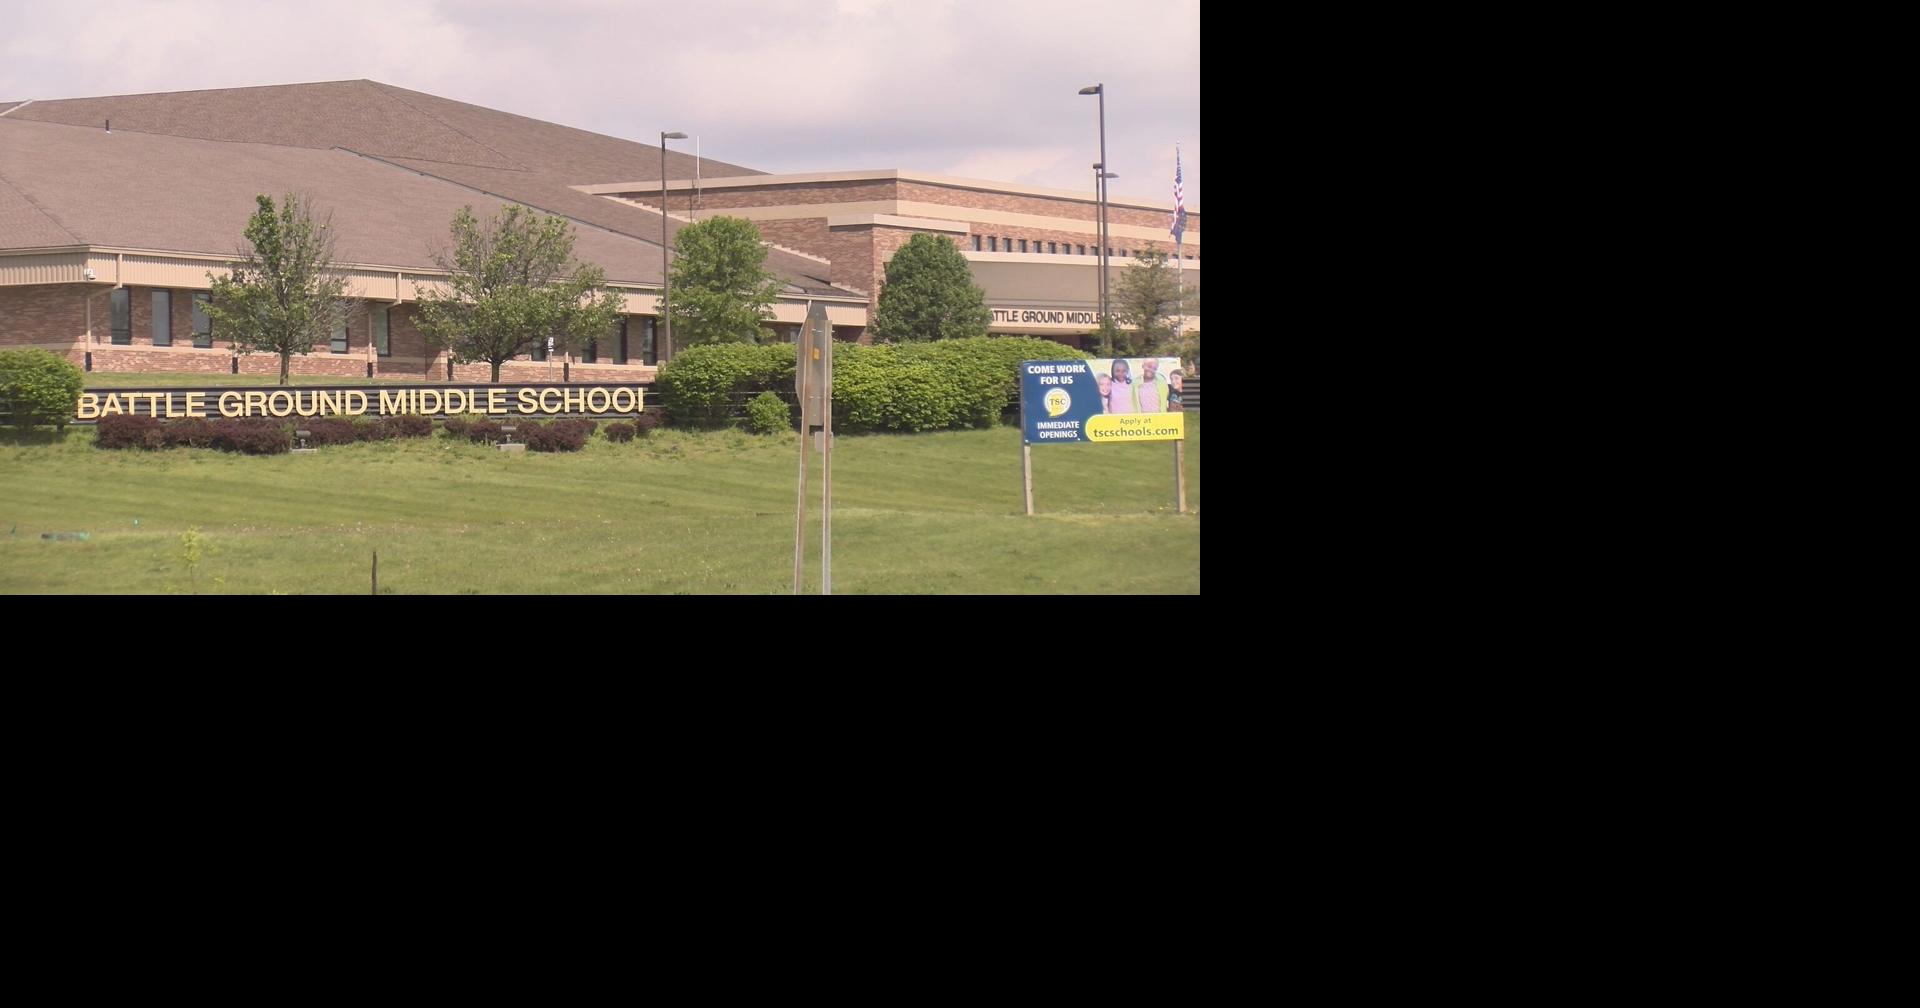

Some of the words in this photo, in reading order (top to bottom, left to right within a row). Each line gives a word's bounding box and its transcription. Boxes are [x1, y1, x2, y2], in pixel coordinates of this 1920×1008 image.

[991, 310, 1018, 322] TTLE
[1022, 310, 1064, 323] GROUND
[1066, 312, 1100, 324] MIDDLE
[1027, 365, 1056, 374] COME
[1057, 364, 1086, 373] WORK
[1040, 376, 1059, 385] FOR
[1060, 376, 1073, 384] US
[77, 392, 206, 419] BATTLE
[218, 390, 367, 417] GROUND
[379, 388, 507, 415] MIDDLE
[1049, 398, 1066, 406] TSC
[1037, 421, 1080, 430] IMMEDIATE
[1119, 418, 1141, 426] Apply
[1039, 430, 1078, 439] OPENINGS
[1093, 426, 1179, 437] tscschools.com
